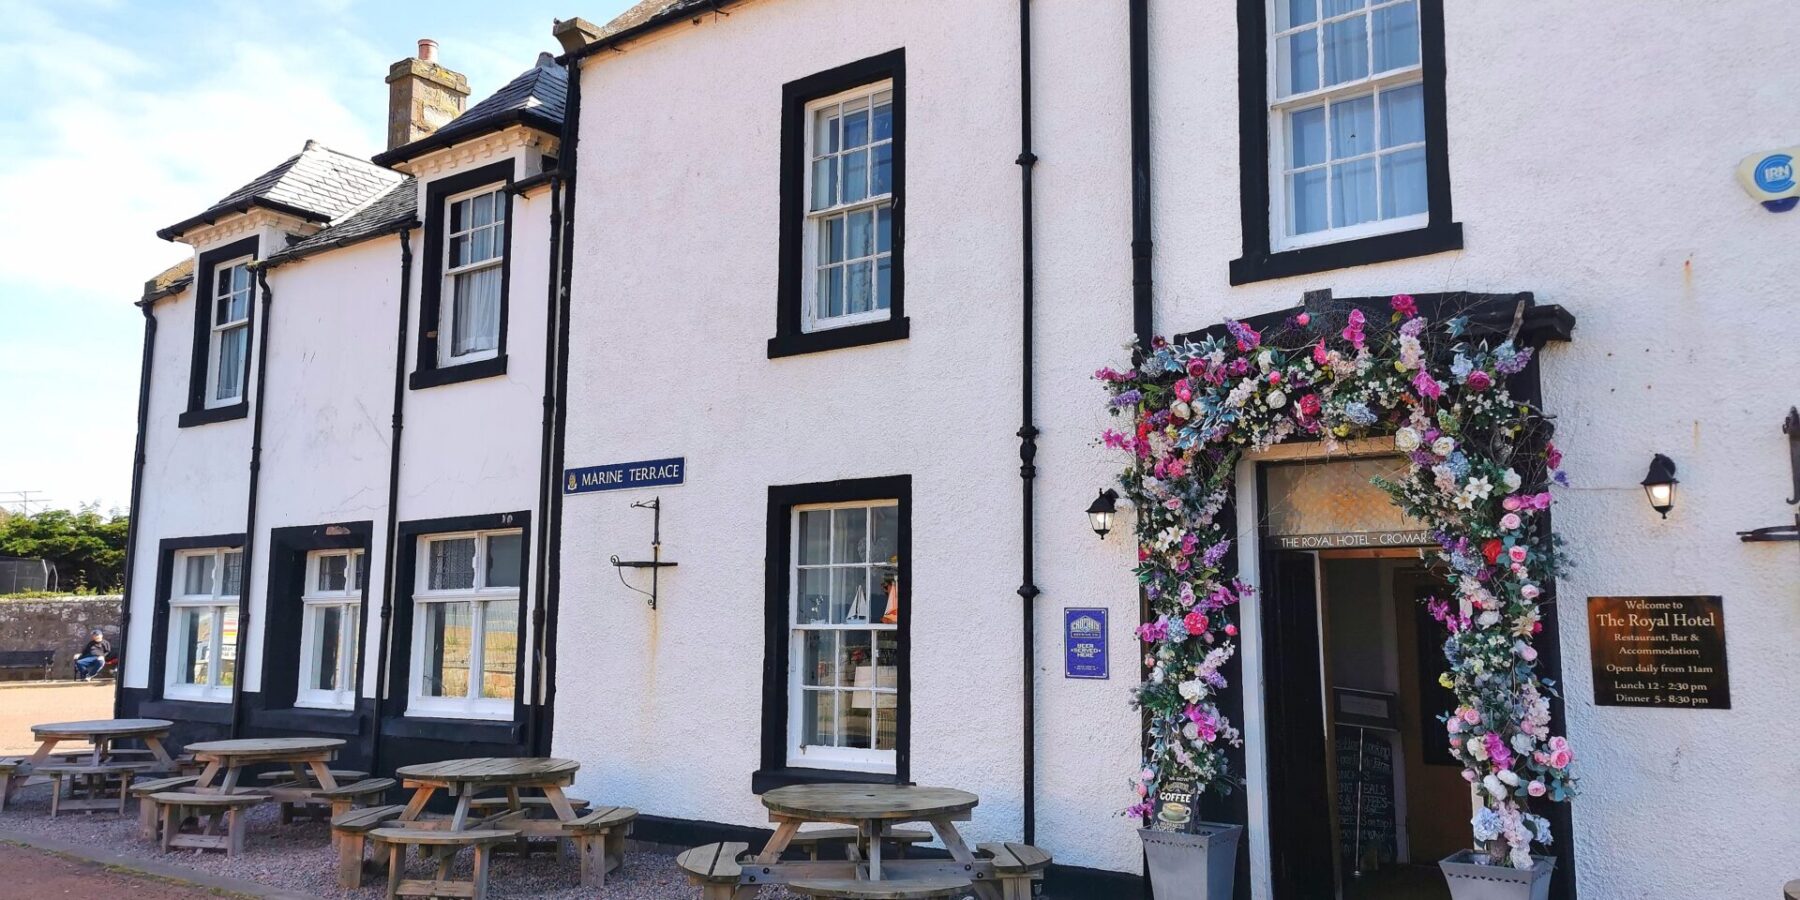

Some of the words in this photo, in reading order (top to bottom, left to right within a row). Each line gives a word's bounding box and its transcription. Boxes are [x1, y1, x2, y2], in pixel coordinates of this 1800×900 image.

[581, 470, 623, 486] MARINE
[629, 464, 680, 481] TERRACE
[1281, 537, 1299, 548] THE
[1302, 536, 1334, 547] ROYAL
[1336, 534, 1370, 546] HOTEL
[1379, 532, 1427, 545] CROMAR
[1625, 600, 1671, 610] Welcome
[1672, 601, 1683, 610] to
[1596, 613, 1625, 627] The
[1628, 613, 1669, 631] Royal
[1673, 612, 1715, 627] Hotel
[1614, 633, 1669, 642] Restaurant,
[1671, 633, 1687, 641] Bar
[1619, 646, 1699, 655] Accommodation
[1606, 664, 1633, 674] Open
[1635, 664, 1659, 675] daily
[1661, 664, 1685, 673] from
[1688, 665, 1713, 673] 11am
[1614, 681, 1645, 690] Lunch
[1648, 682, 1659, 690] 12
[1668, 682, 1689, 691] 2:30
[1690, 684, 1708, 693] pm
[1616, 693, 1650, 703] Dinner
[1654, 695, 1660, 703] 5
[1668, 695, 1690, 704] 8:30
[1691, 697, 1709, 706] pm
[1160, 792, 1191, 803] COFFEE
